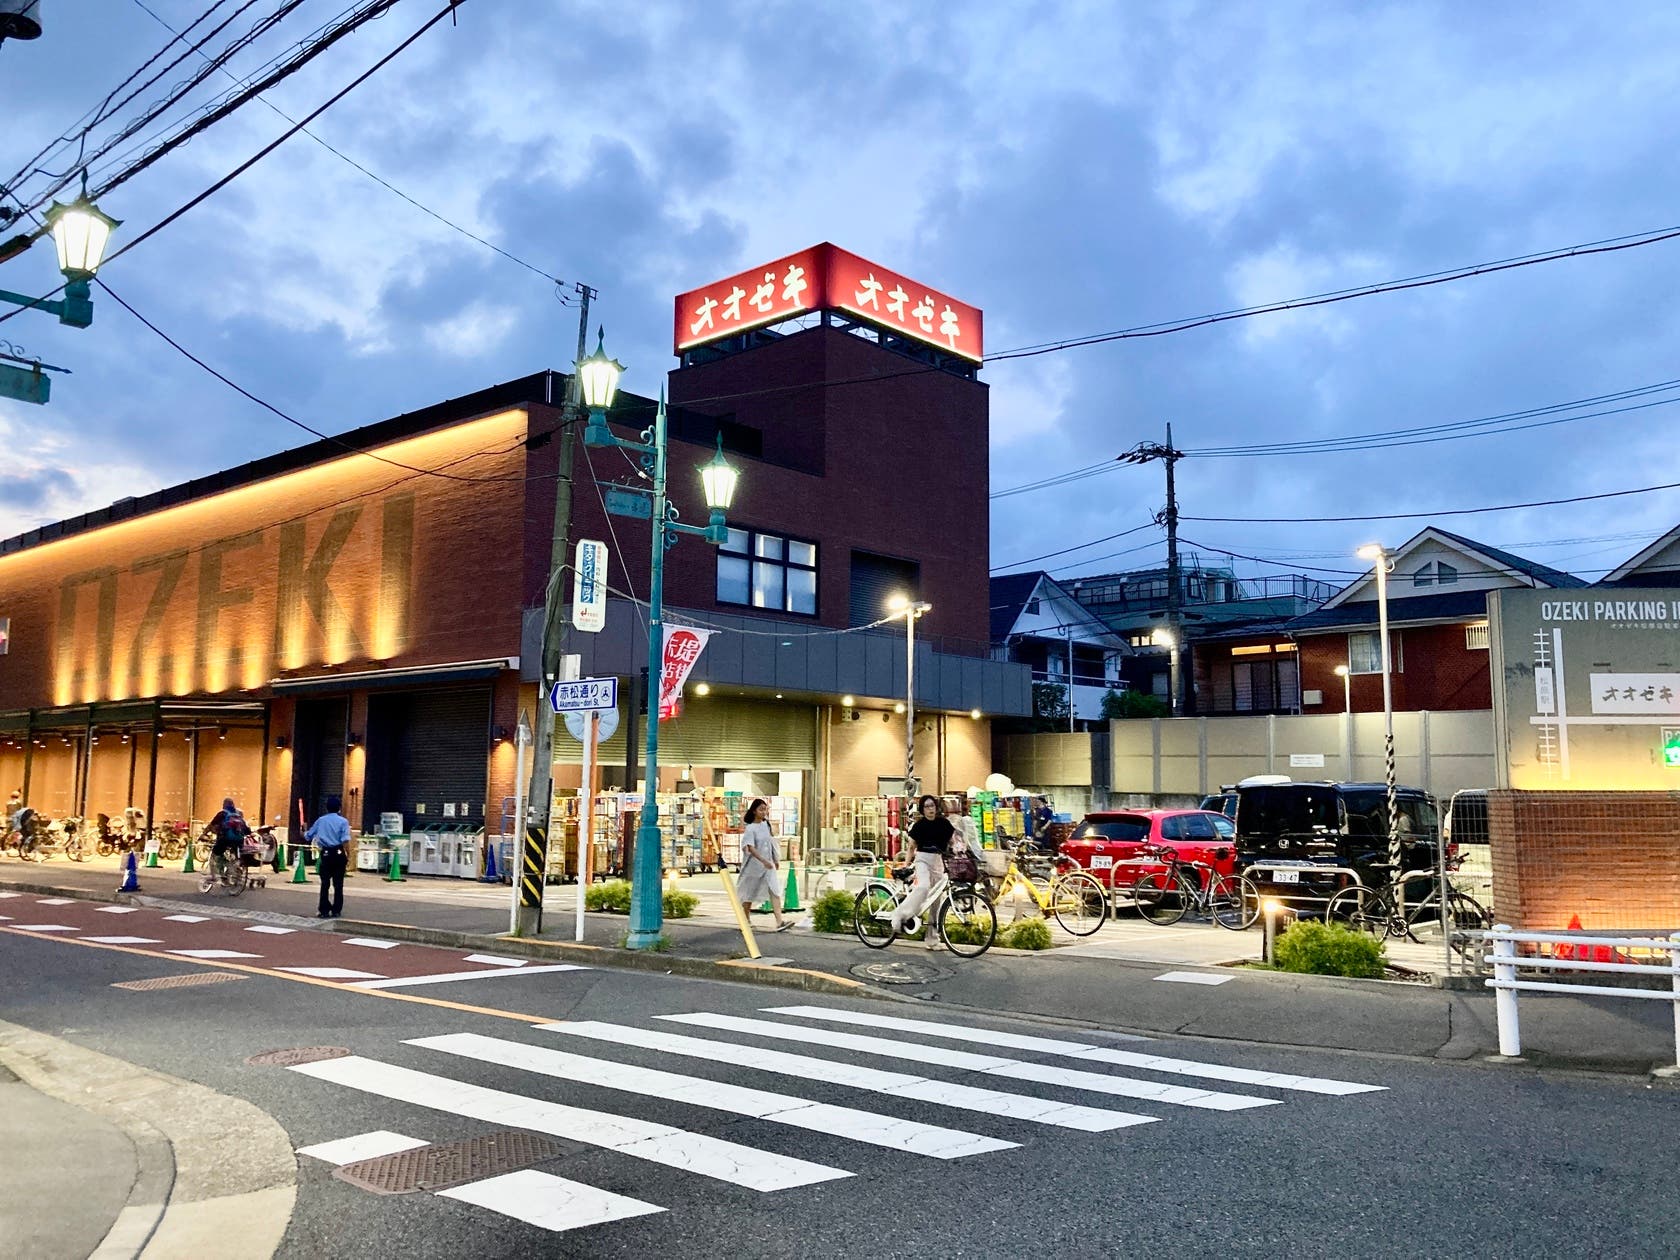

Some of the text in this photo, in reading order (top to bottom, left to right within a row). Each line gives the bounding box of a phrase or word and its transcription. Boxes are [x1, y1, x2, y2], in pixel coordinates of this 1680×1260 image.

[690, 264, 808, 336] オオゼキ
[854, 272, 961, 349] オオゼキ
[1541, 601, 1589, 621] OZEKI
[1594, 601, 1667, 621] PARKING
[560, 684, 599, 699] 赤松通り
[1602, 686, 1674, 704] オオゼキ
